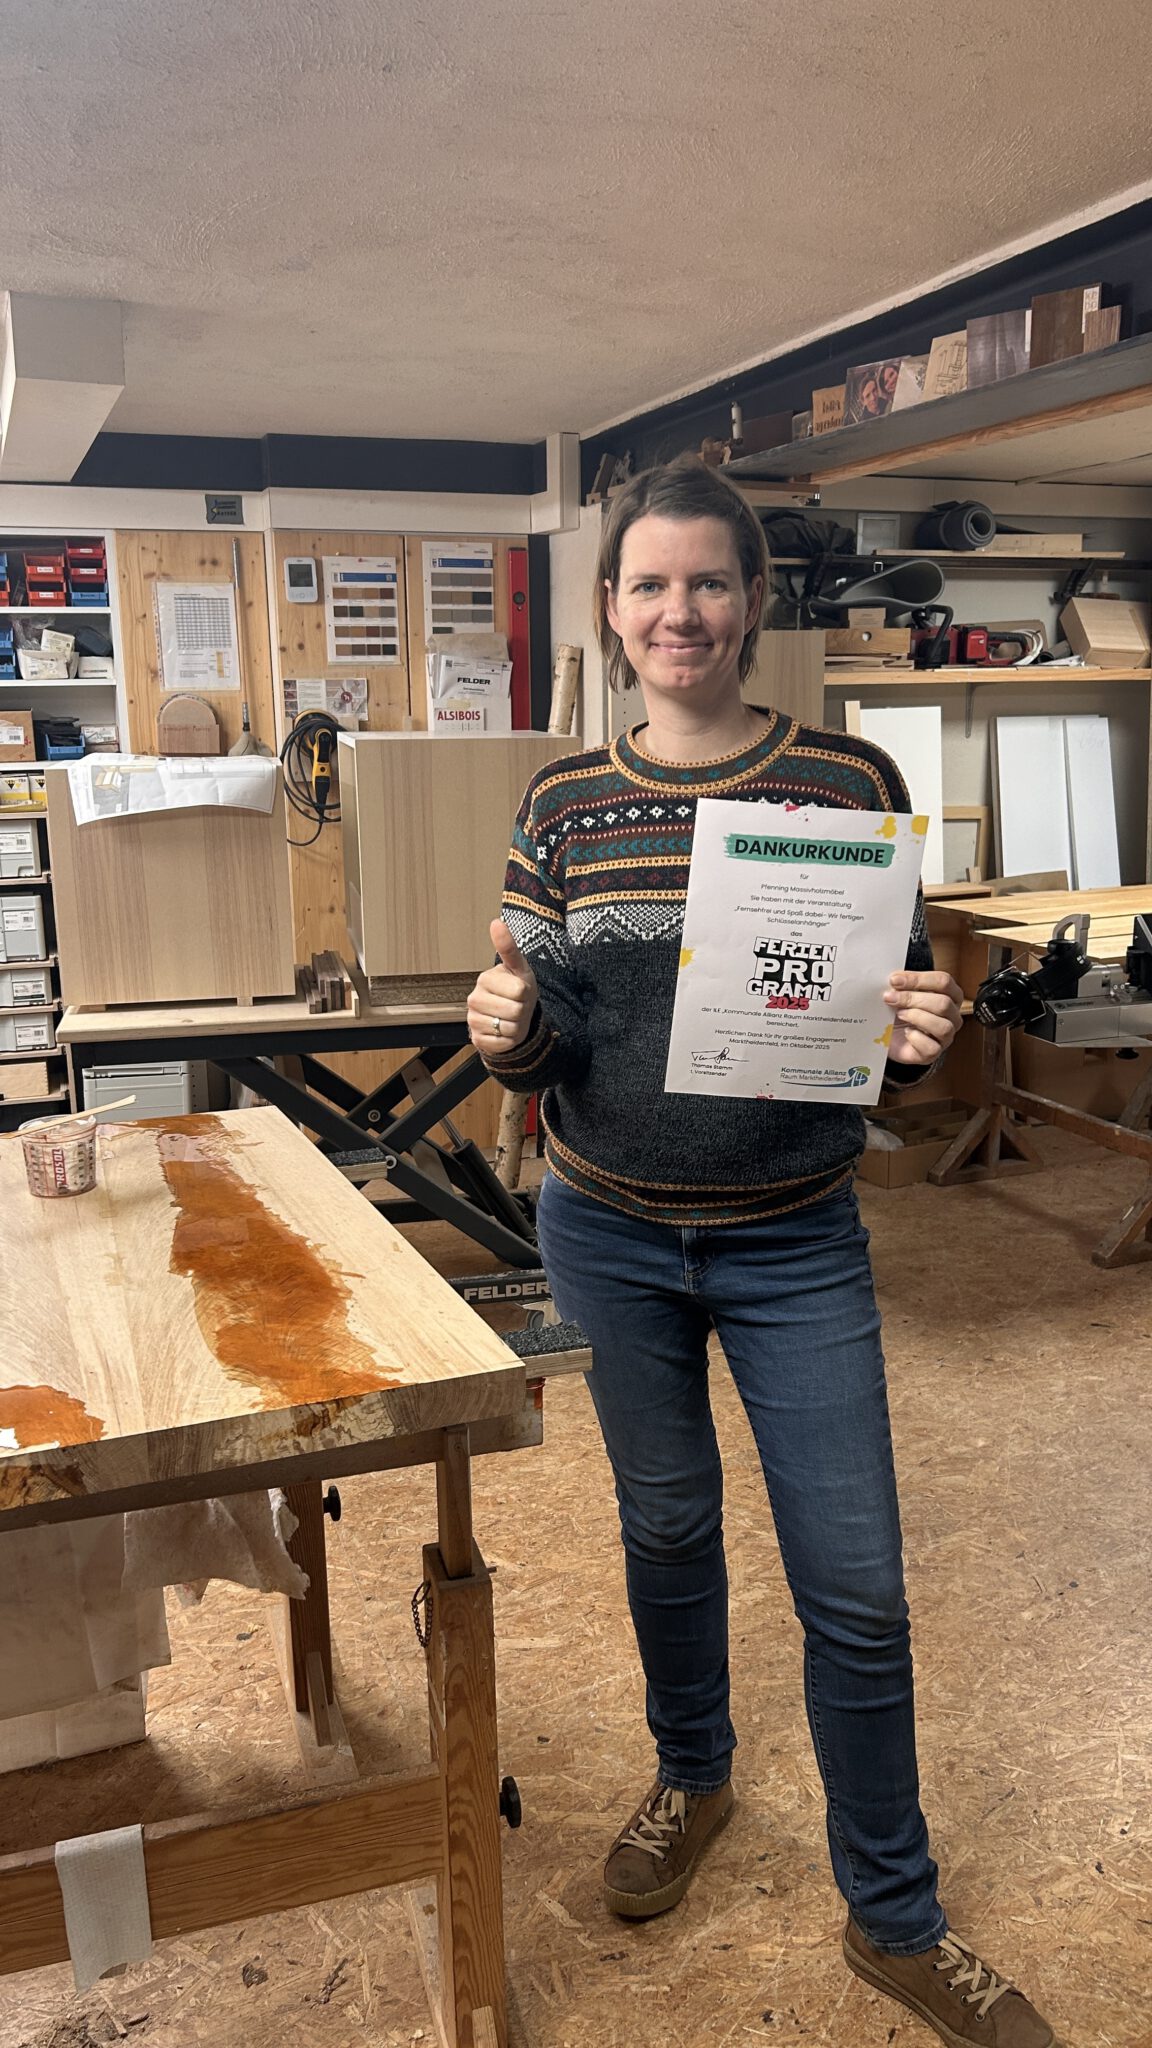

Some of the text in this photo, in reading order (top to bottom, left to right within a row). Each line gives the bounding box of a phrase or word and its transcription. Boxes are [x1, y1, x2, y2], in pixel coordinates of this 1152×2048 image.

[457, 677, 491, 685] FELDER
[437, 710, 481, 721] ALSIBOIS
[734, 838, 885, 864] DANKURKUNDE
[761, 883, 845, 896] Pfenning Massivholzmöbel
[807, 899, 852, 910] Veranstaltung
[787, 909, 803, 917] Spaß
[839, 913, 865, 922] fertigen
[753, 936, 837, 962] FERIEN
[754, 957, 834, 983] PRO
[746, 979, 832, 1001] GRAMM
[765, 995, 810, 1010] 2025
[803, 1015, 853, 1023] Marktheidenfeld
[780, 1066, 823, 1075] Kommunale
[799, 1074, 847, 1082] Marktheidenfeld
[463, 1281, 551, 1301] FELDER
